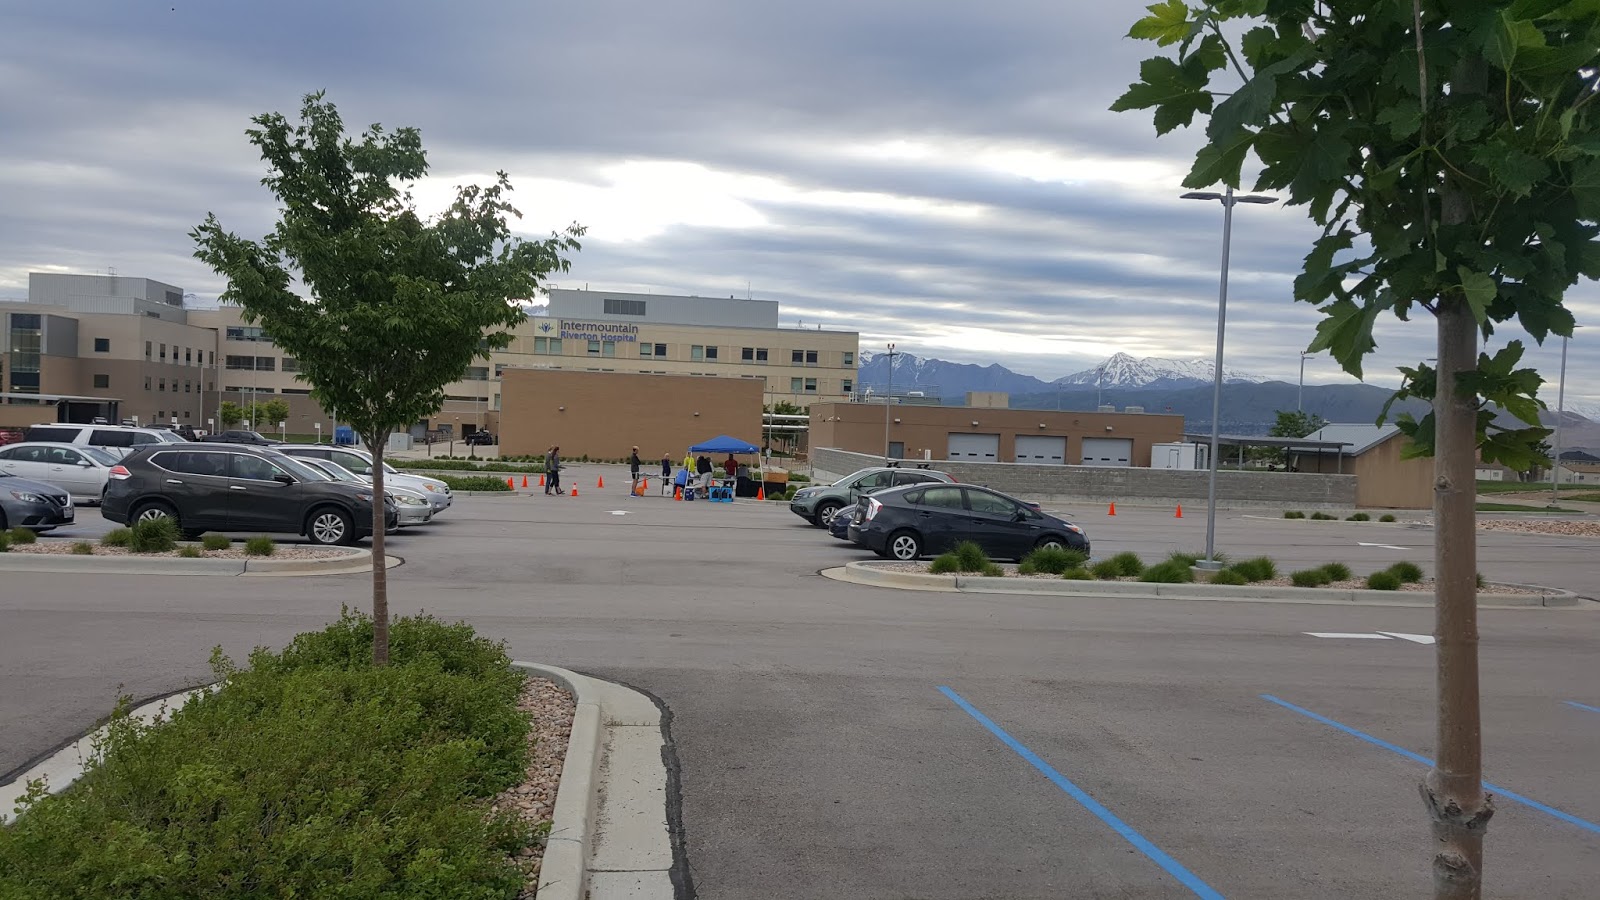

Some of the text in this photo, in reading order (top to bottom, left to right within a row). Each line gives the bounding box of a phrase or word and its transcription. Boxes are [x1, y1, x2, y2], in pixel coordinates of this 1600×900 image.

[560, 320, 638, 333] Intermountain
[561, 330, 637, 342] Riverton Hospital
